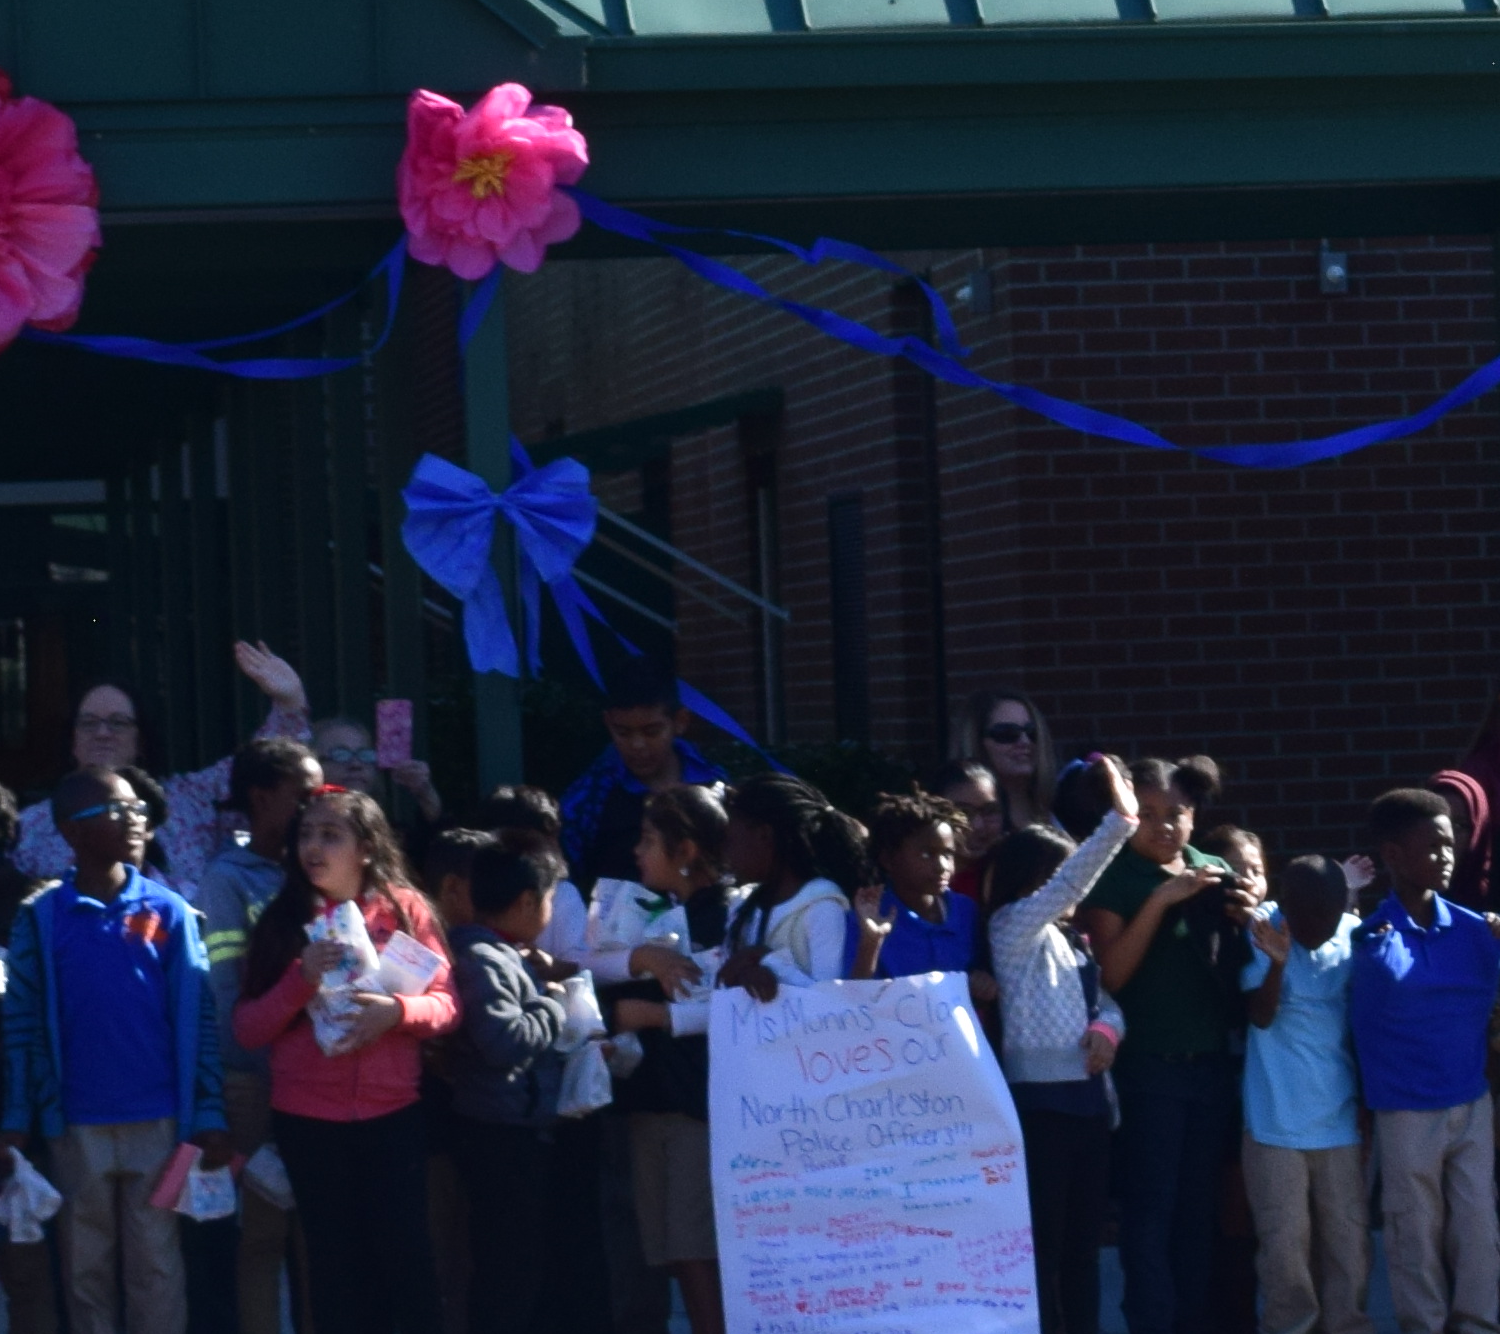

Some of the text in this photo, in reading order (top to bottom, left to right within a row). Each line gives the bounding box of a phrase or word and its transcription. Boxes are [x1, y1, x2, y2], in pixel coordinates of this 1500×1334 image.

[795, 1038, 895, 1084] loves
[740, 1087, 965, 1129] North Charleston
[780, 1128, 853, 1156] Police
